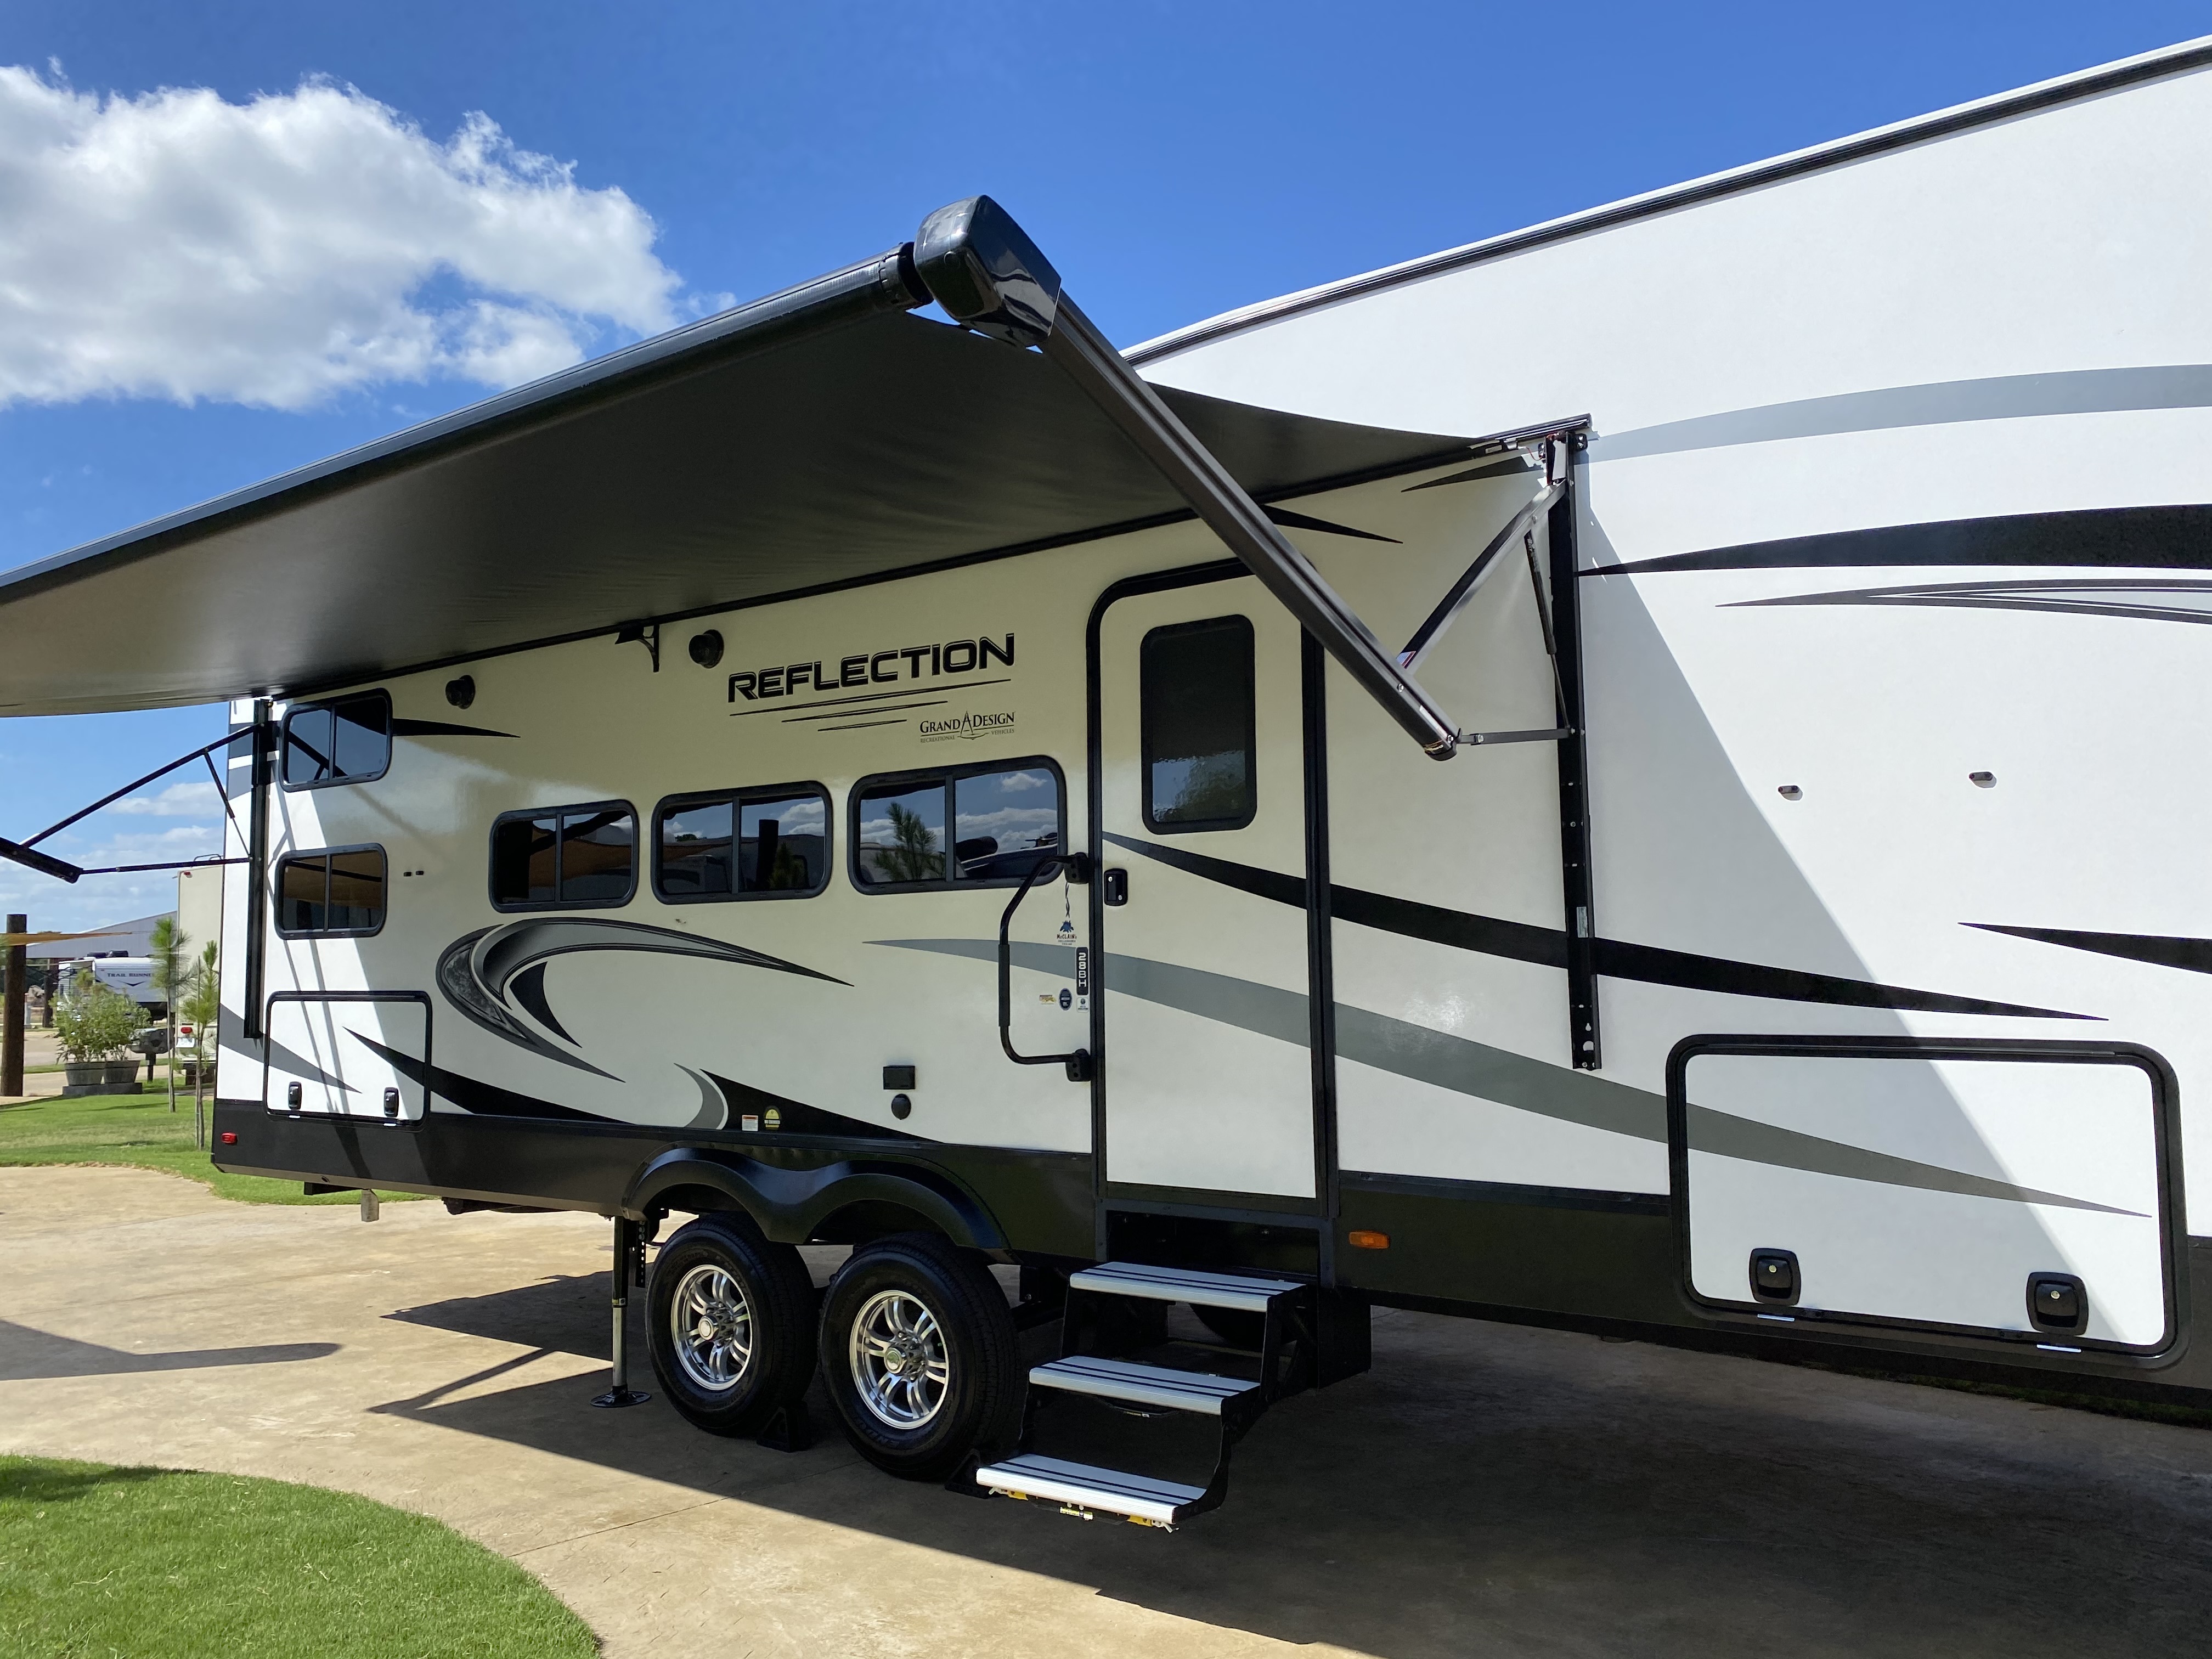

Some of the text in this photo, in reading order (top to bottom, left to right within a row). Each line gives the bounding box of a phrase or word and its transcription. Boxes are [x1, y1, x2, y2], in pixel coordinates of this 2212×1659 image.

[728, 633, 1015, 703] REFLECTION
[920, 712, 1015, 733] GRAND DESIGN
[920, 735, 955, 743] RECREATIONAL
[1078, 952, 1087, 988] 28BH
